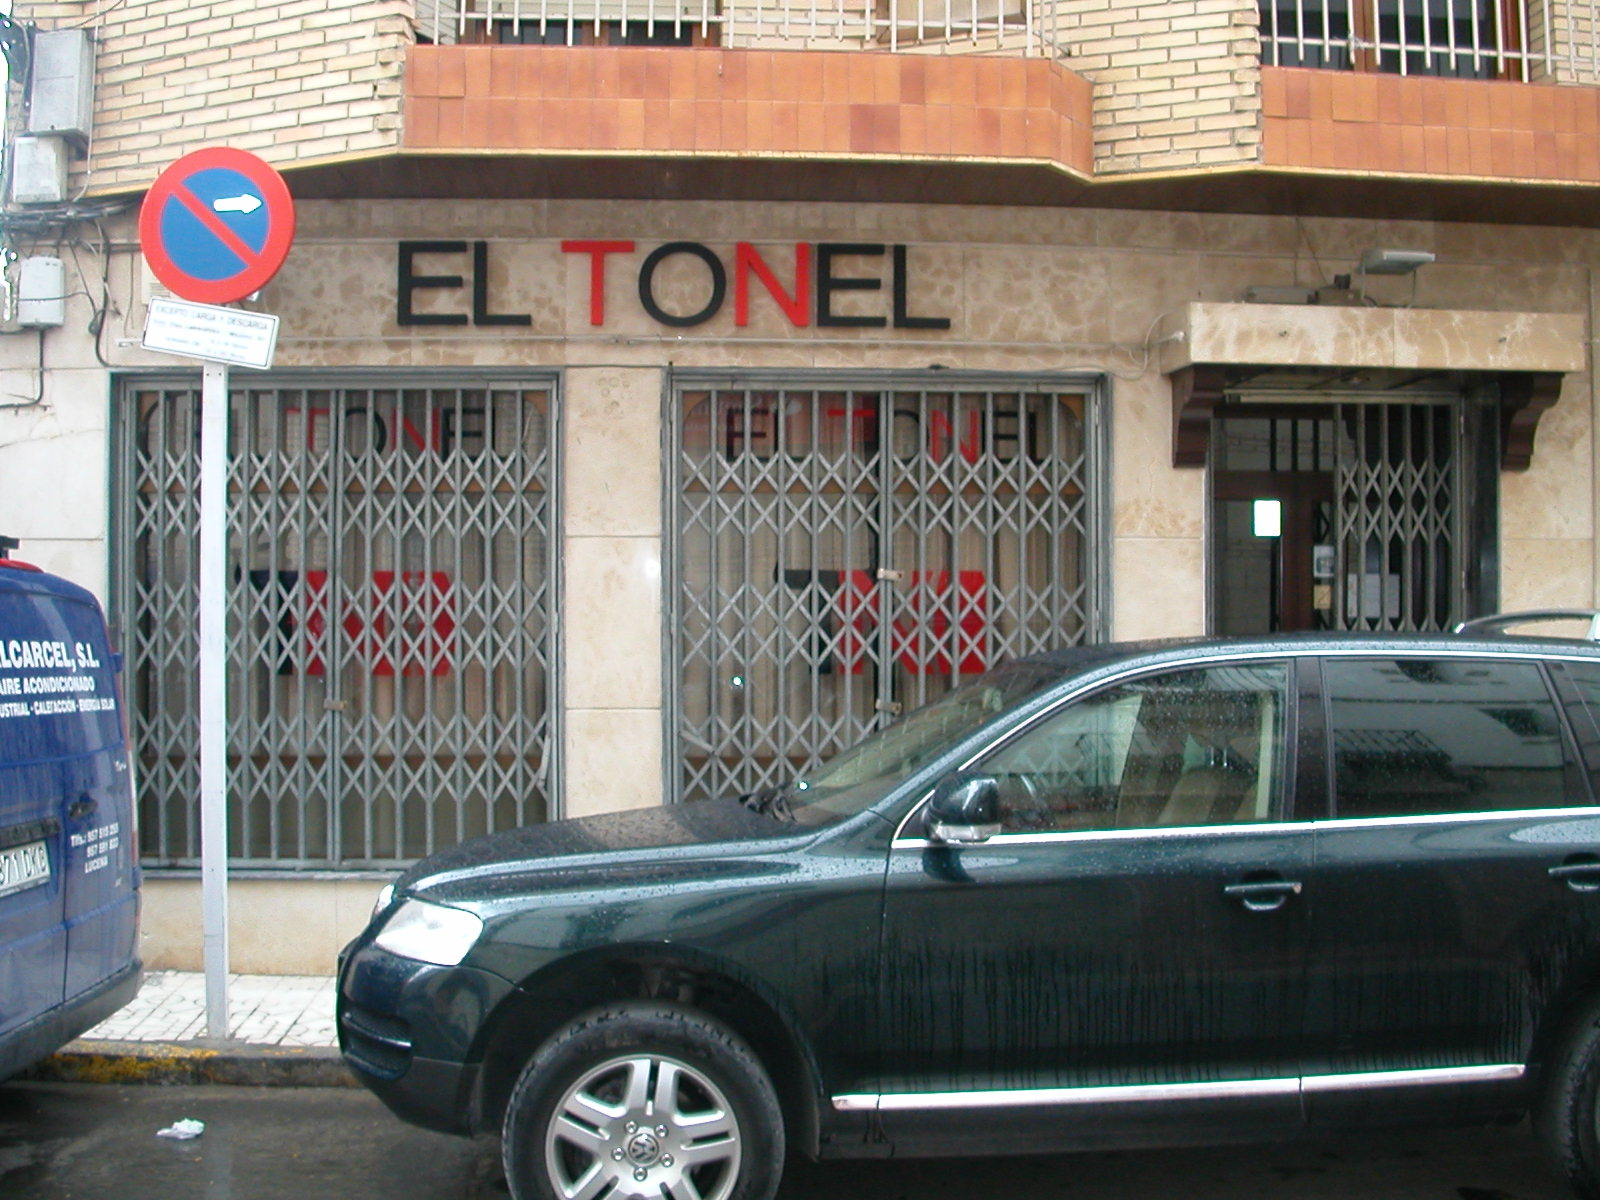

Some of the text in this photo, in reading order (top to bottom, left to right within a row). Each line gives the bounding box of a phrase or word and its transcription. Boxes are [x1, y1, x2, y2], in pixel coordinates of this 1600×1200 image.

[397, 240, 951, 330] EL TONEL
[155, 305, 189, 317] EXCEPTO
[191, 310, 217, 321] CARGA
[227, 316, 268, 331] DESCARGA
[0, 640, 100, 673] LCARCEL, S.L.
[23, 676, 95, 694] ACONDICIONADO
